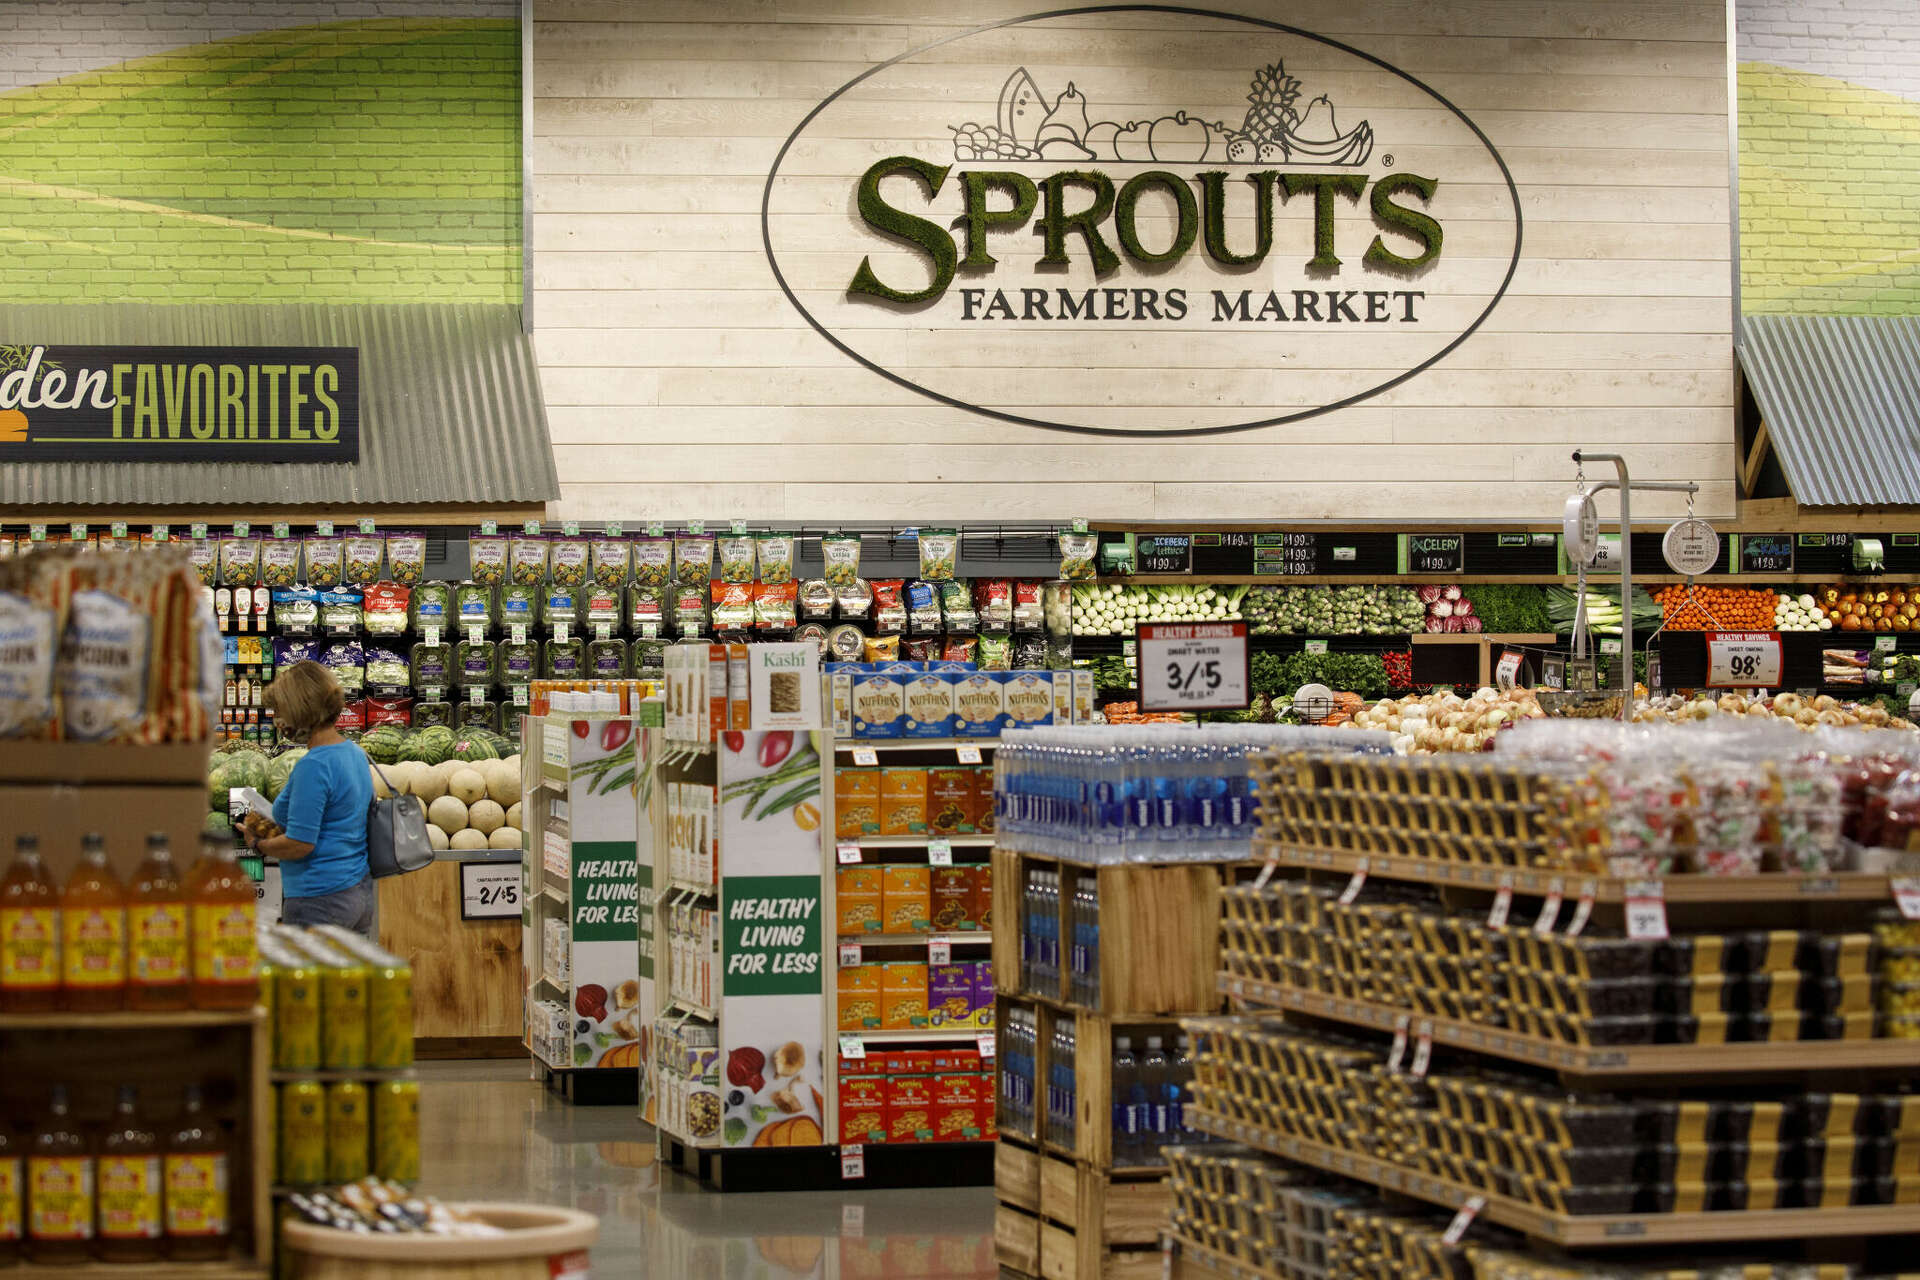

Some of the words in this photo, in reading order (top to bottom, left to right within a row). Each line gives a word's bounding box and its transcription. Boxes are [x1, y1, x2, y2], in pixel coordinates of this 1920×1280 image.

[847, 155, 1444, 306] SPROUTS
[960, 287, 1188, 322] FARMERS
[1211, 289, 1425, 324] MARKET
[112, 363, 340, 441] FAVORITES
[1154, 537, 1189, 546] ICEBERG
[1424, 537, 1460, 551] CELERY
[1761, 544, 1791, 556] KALE
[1152, 625, 1193, 640] HEALTHY
[1194, 624, 1234, 638] SAVINGS
[1716, 633, 1743, 641] HEALTHY
[763, 649, 806, 668] Kashi
[1195, 647, 1220, 655] WATER
[577, 860, 638, 878] HEALTH
[586, 882, 638, 901] LIVING
[576, 905, 609, 923] FOR
[613, 905, 639, 923] LES
[729, 897, 817, 921] HEALTHY
[740, 925, 806, 947] LIVING
[728, 953, 766, 975] FOR
[771, 952, 818, 974] LESS
